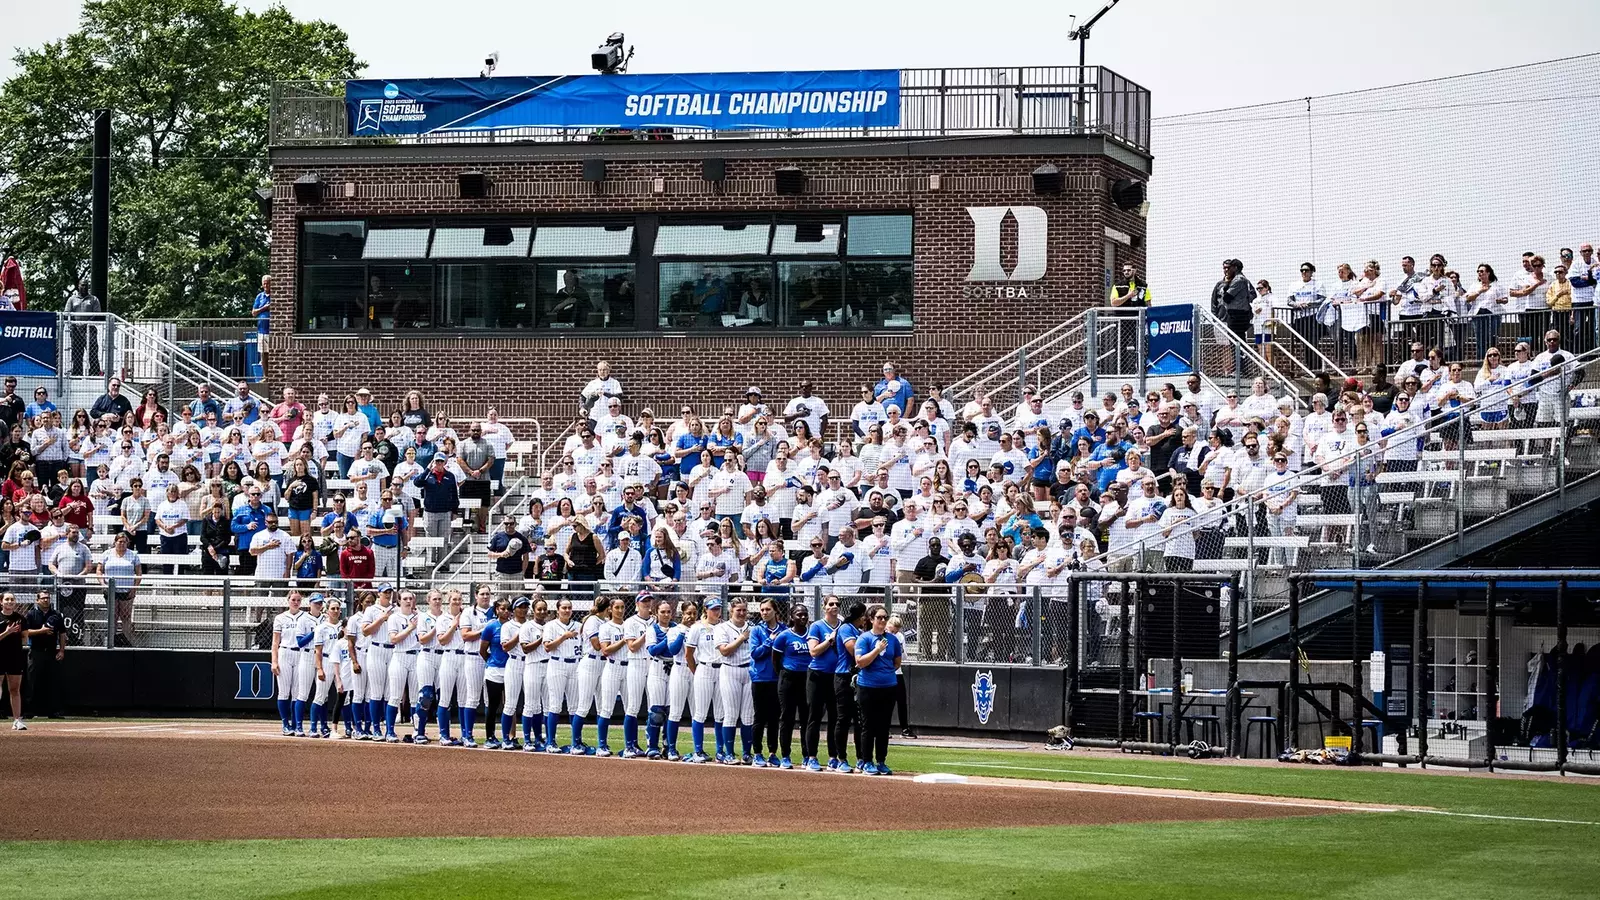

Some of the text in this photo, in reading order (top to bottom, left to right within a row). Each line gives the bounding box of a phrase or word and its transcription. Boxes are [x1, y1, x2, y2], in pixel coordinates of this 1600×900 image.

[382, 103, 425, 115] SOFTBALL
[624, 90, 888, 116] SOFTBALL CHAMPIONSHIP
[381, 114, 427, 122] CHAMPIONSHIP
[963, 205, 1048, 281] D
[962, 286, 1049, 299] SOFTBALL
[4, 325, 53, 339] SOFTBALL
[1159, 320, 1191, 335] SOFTBALL
[792, 640, 809, 650] Du
[234, 661, 276, 700] D
